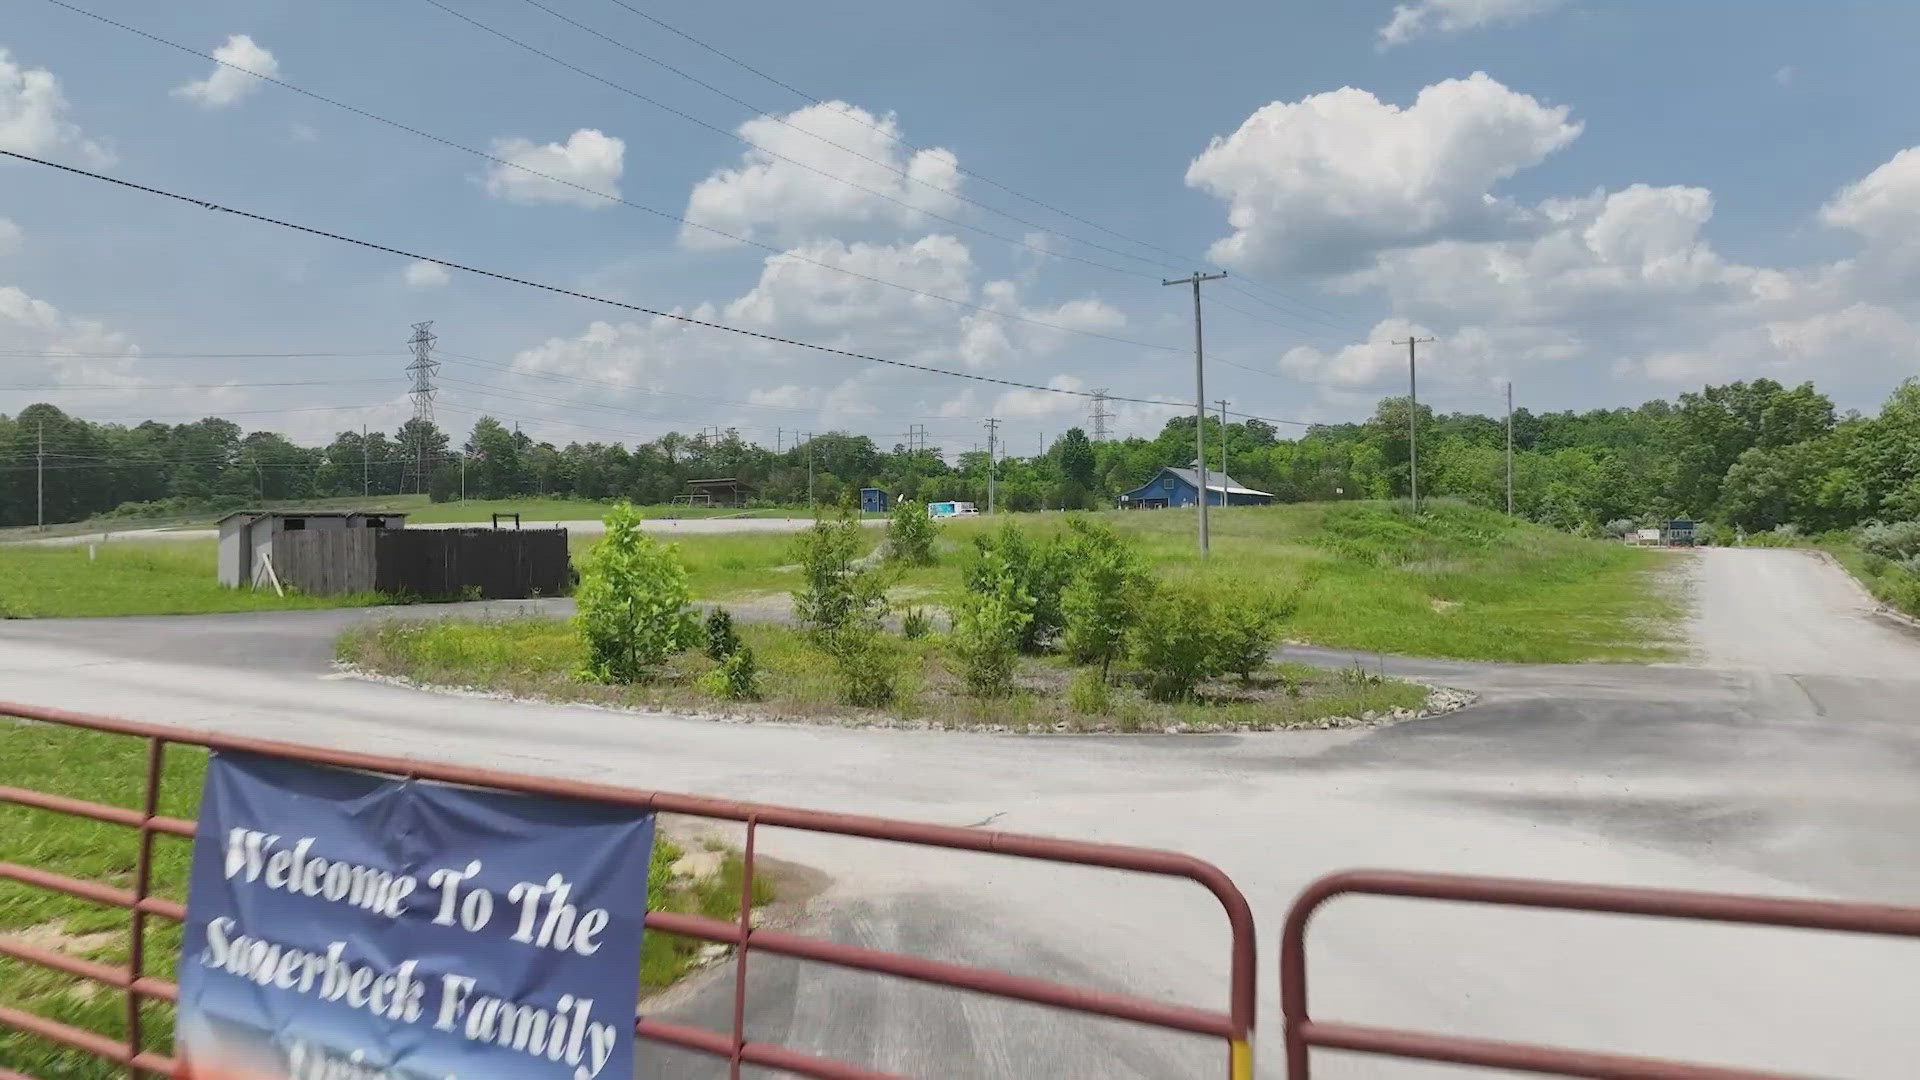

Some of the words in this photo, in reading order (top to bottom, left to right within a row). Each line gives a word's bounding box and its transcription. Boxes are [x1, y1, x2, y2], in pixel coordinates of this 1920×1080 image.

[225, 826, 418, 918] Welcome
[428, 859, 494, 932] To
[508, 873, 610, 956] The
[201, 916, 425, 1024] Sauerbeck
[433, 973, 618, 1080] Family
